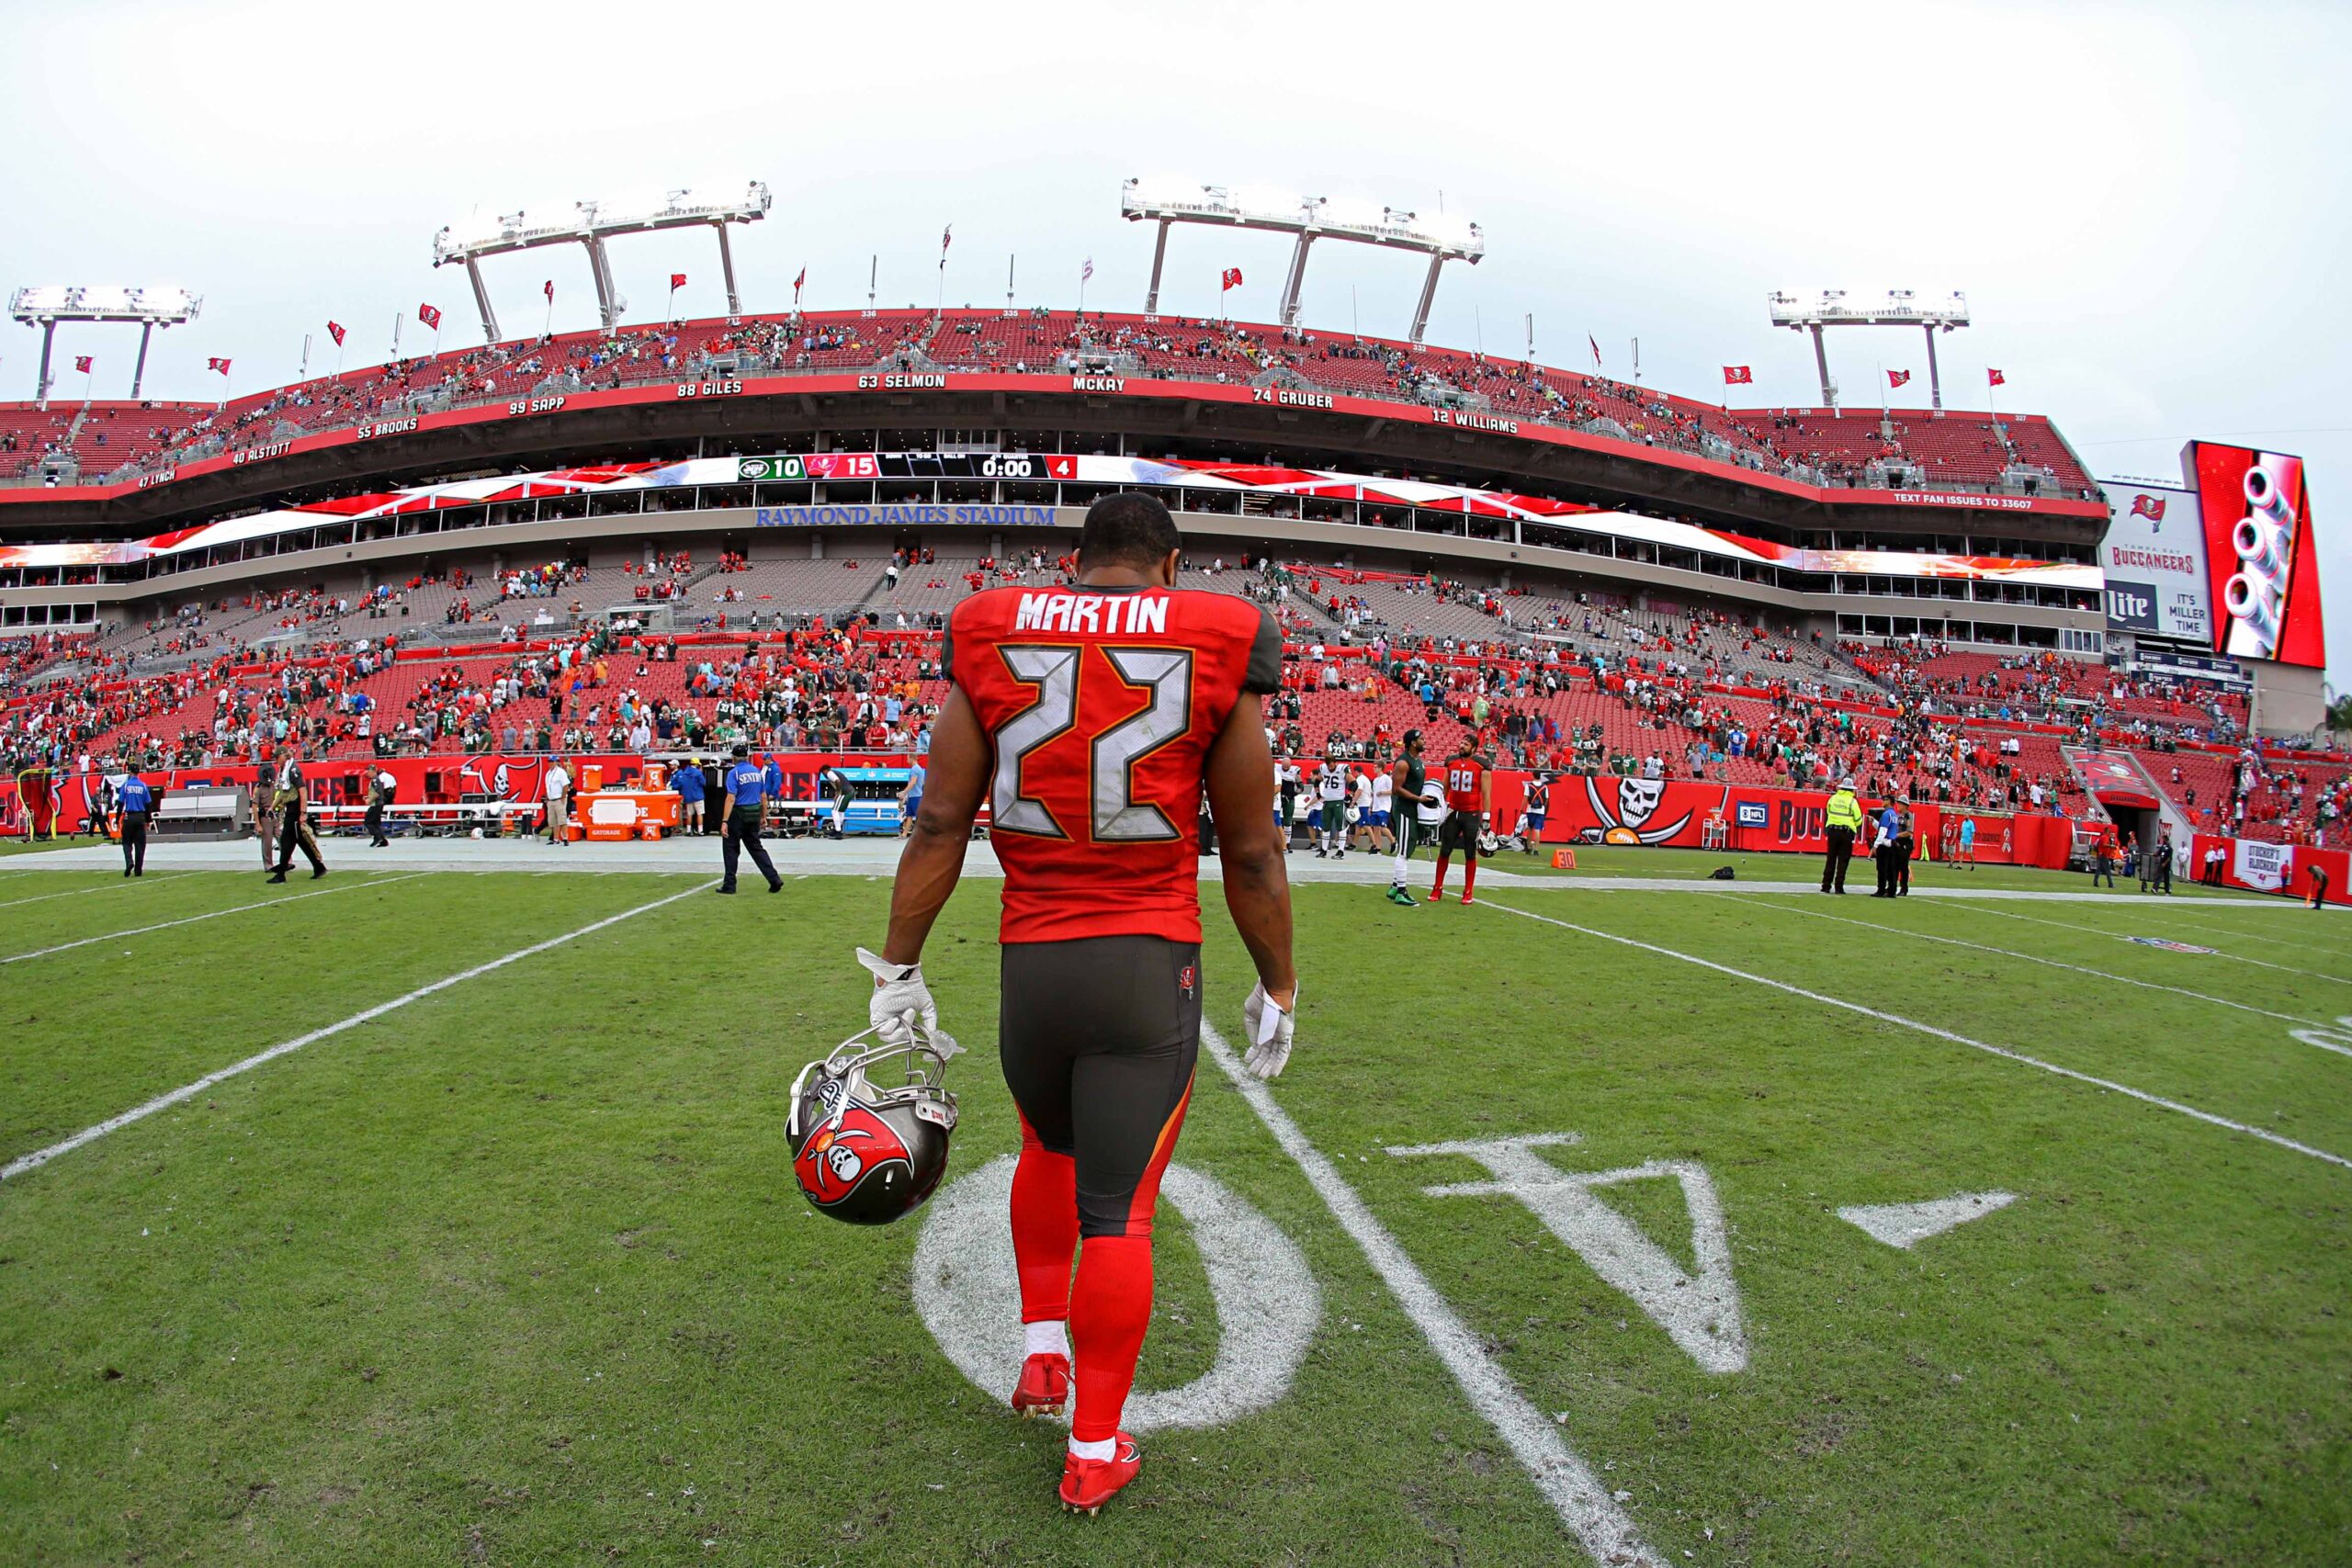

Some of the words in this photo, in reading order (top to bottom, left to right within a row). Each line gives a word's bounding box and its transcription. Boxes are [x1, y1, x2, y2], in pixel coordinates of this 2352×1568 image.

[677, 384, 696, 397] 88
[702, 381, 742, 395] GILES
[858, 375, 878, 389] 63
[885, 374, 945, 389] SELMON
[509, 401, 526, 414] 99
[531, 397, 565, 412] SAPP
[1253, 389, 1272, 402] 74
[1279, 390, 1333, 409] GRUBER
[357, 425, 372, 439] 55
[375, 418, 417, 436] BROOKS
[1432, 410, 1449, 423] 12
[1455, 412, 1518, 434] WILLIAMS
[232, 452, 246, 464] 40
[247, 442, 291, 461] ALSTOTT
[774, 459, 799, 477] 10
[847, 457, 873, 475] 15
[982, 460, 1032, 477] 0:00
[1056, 462, 1069, 475] 4
[138, 477, 149, 489] 47
[151, 469, 175, 486] LYNCH
[1894, 493, 1921, 503] TEXT
[1923, 494, 1944, 504] FAN
[1946, 496, 1983, 506] ISSUES
[1984, 498, 1999, 506] TO
[2001, 499, 2032, 509] 33607
[756, 507, 870, 527] RAYMOND
[874, 506, 949, 525] JAMES
[956, 506, 1056, 526] STADIUM
[2111, 547, 2194, 574] BUCCANEERS
[2107, 590, 2148, 622] Lite
[2177, 593, 2196, 605] IT'S
[1015, 592, 1170, 634] MARTIN
[2169, 606, 2206, 620] MILLER
[2176, 620, 2200, 633] TIME
[991, 642, 1196, 844] 22
[1323, 775, 1339, 789] 76
[1450, 770, 1474, 792] 88
[126, 785, 144, 795] SENTRY
[1749, 810, 1764, 820] NFL
[1558, 852, 1574, 867] 30
